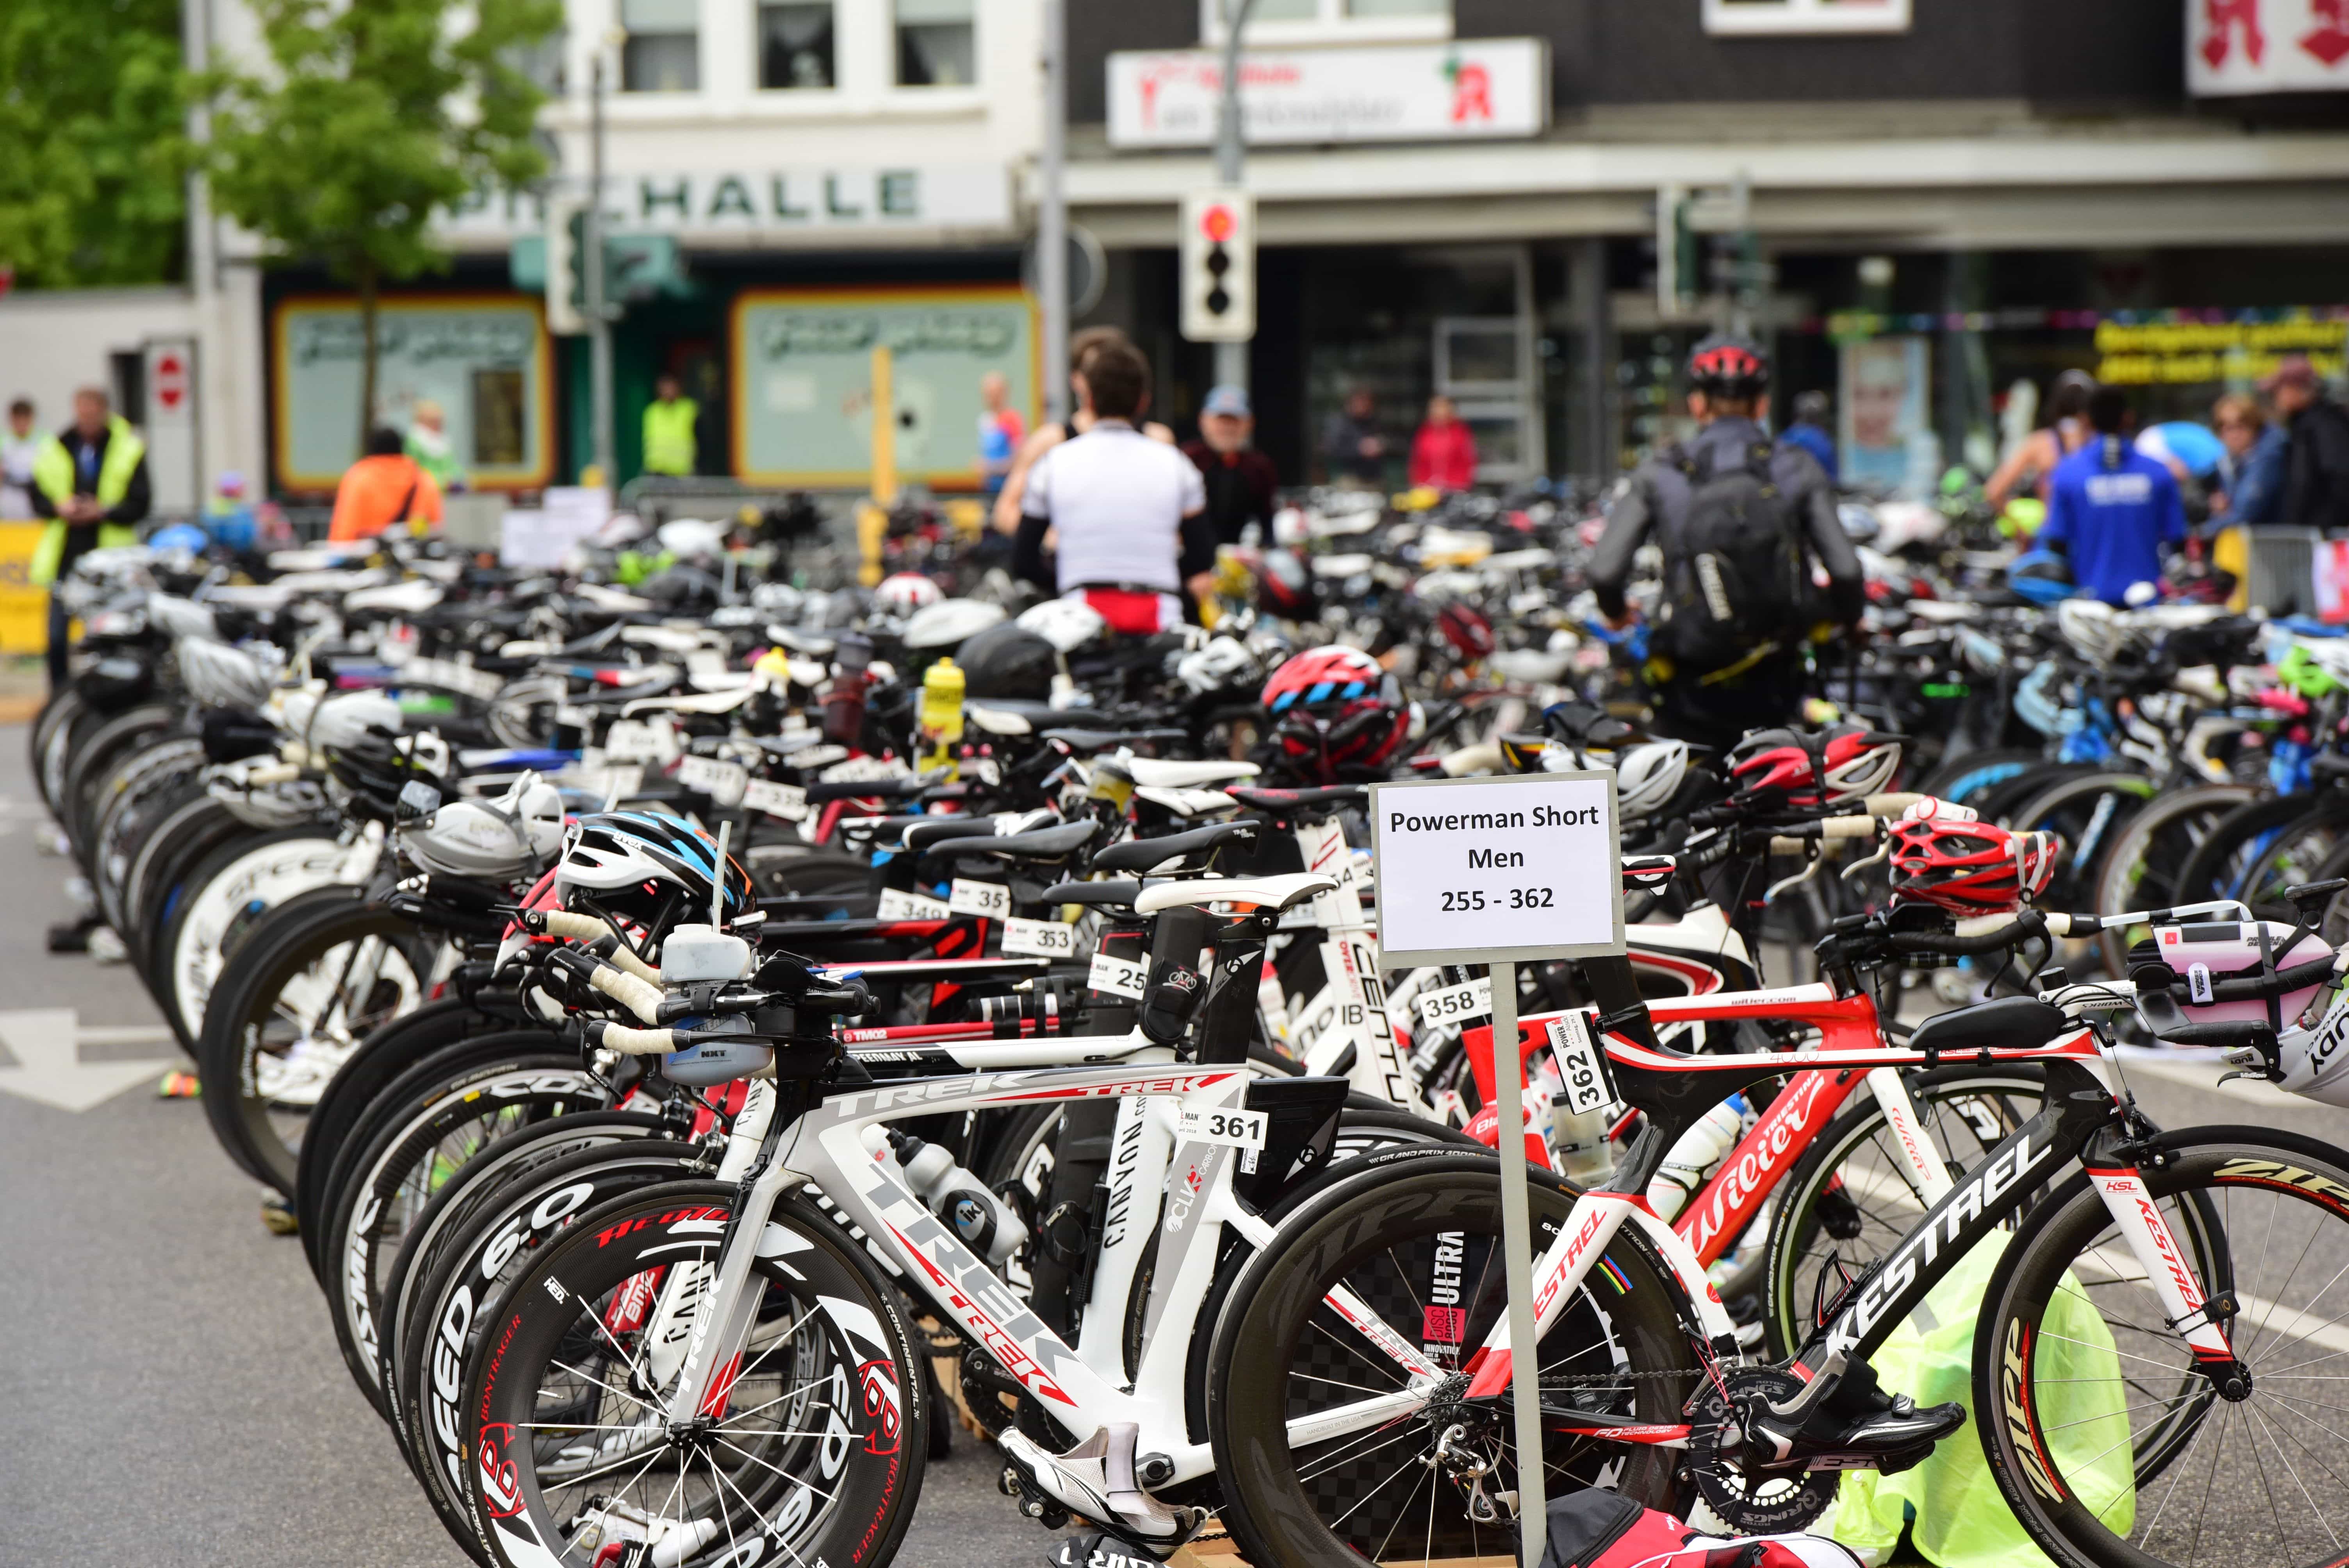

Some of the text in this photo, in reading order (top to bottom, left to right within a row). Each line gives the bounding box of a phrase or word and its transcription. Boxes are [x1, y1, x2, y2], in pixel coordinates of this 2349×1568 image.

[1390, 805, 1599, 832] Powerman Short
[612, 831, 643, 850] uvex
[1468, 848, 1524, 869] Men
[1441, 890, 1485, 911] 255
[1510, 887, 1554, 909] 362
[1037, 928, 1069, 948] 353
[1342, 1005, 1363, 1026] IB
[1426, 991, 1475, 1018] 358
[701, 1050, 726, 1058] NXT
[1557, 1026, 1570, 1048] POWER
[823, 1074, 1024, 1117] TREK
[1076, 1076, 1199, 1096] TREK
[1566, 1050, 1599, 1106] 362
[1185, 1113, 1199, 1121] MAN
[1763, 1070, 1819, 1138] TRIESTINA
[1209, 1115, 1260, 1140] 361
[1379, 1150, 1415, 1162] GRAND
[1678, 1074, 1825, 1259] Wilier
[2105, 1181, 2138, 1191] KSL
[482, 1184, 595, 1280] 6.0
[1826, 1134, 2052, 1359] KESTREL
[866, 1164, 1081, 1378] TREK
[1431, 1232, 1464, 1304] ULTRA
[1533, 1210, 1607, 1325] ESTREL
[2134, 1197, 2203, 1319] KESTREL
[677, 1277, 725, 1393] TREK
[936, 1274, 1059, 1391] TREK
[1430, 1310, 1445, 1338] DISC
[1445, 1310, 1458, 1339] 8000
[481, 1313, 522, 1423] BONTRAGER
[885, 1304, 919, 1410] CONTINENTAL
[1423, 1343, 1461, 1355] INNOVATION
[2003, 1317, 2063, 1505] ZIPP
[852, 1456, 899, 1563] BONTRAGER
[1999, 1467, 2020, 1504] 4000
[2018, 1504, 2043, 1535] PRIX
[469, 1505, 493, 1553] ATTACK
